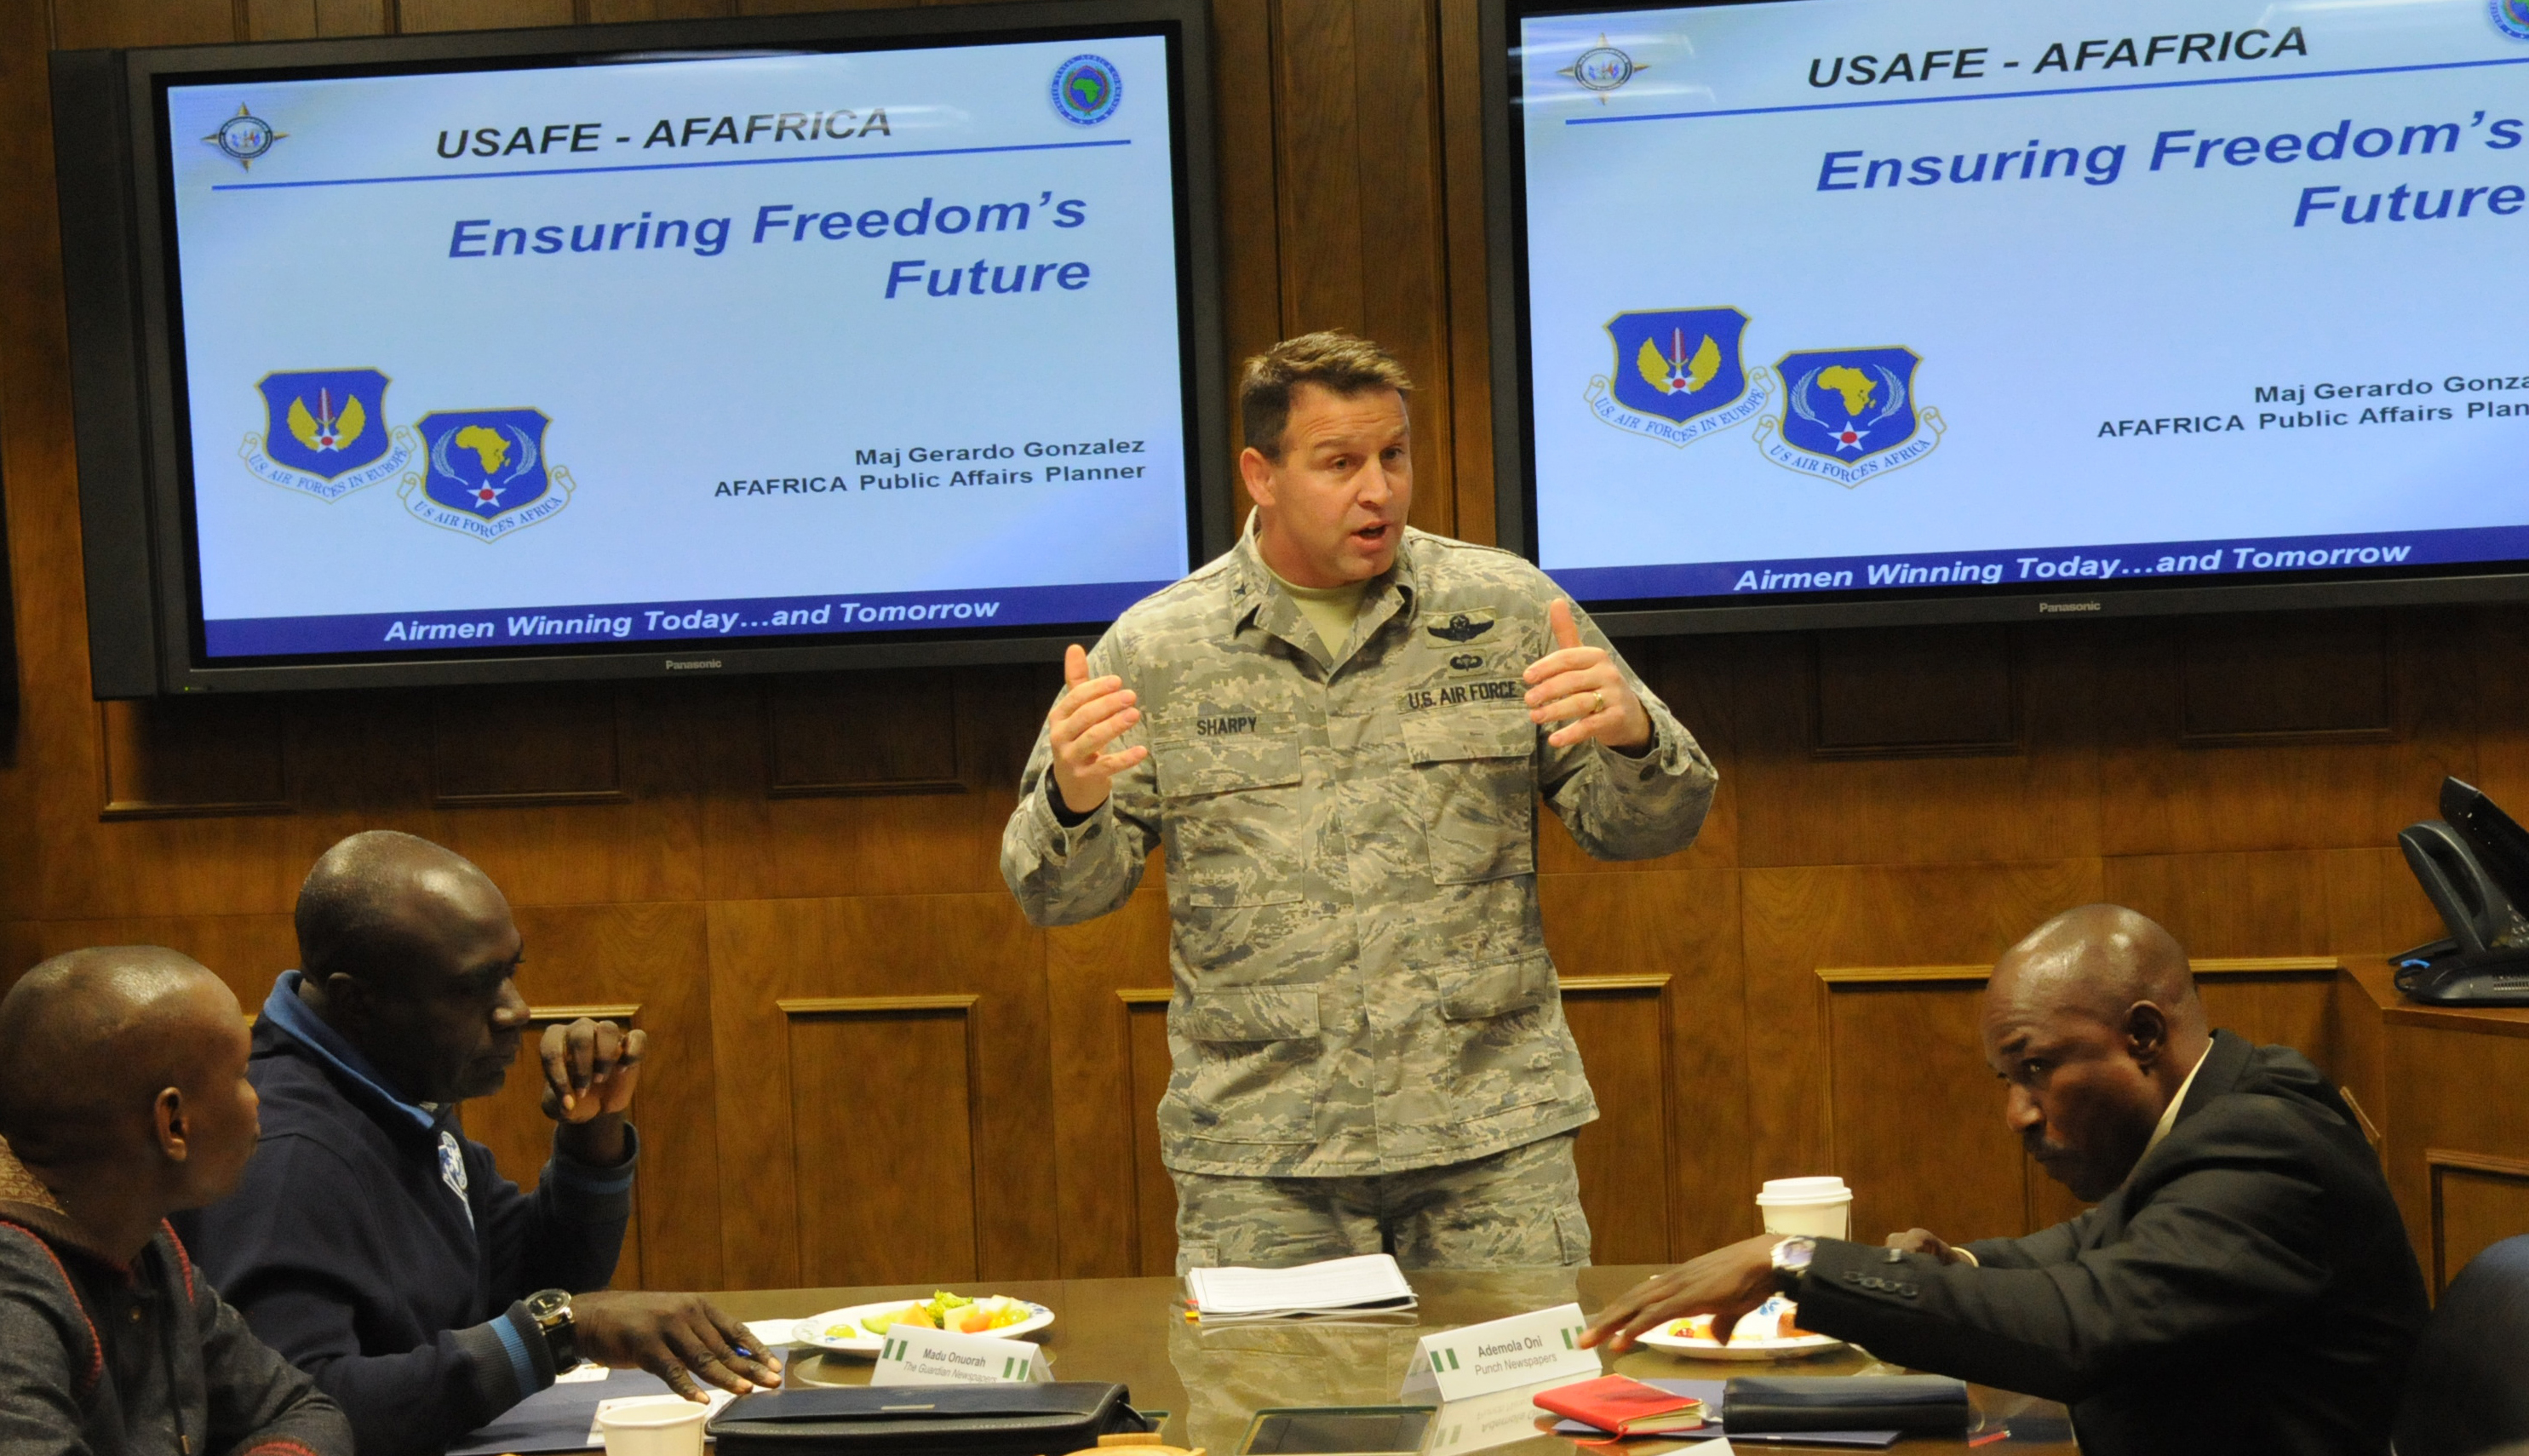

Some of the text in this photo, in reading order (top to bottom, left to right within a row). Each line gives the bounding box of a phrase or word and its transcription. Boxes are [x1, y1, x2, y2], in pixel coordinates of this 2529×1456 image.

[1808, 48, 1988, 89] USAFE
[2033, 26, 2308, 75] AFAFRICA
[437, 123, 602, 159] USAFE
[642, 107, 892, 149] AFAFRICA
[1816, 110, 2525, 192] Ensuring Freedom's
[449, 191, 1087, 257] Ensuring Freedom's
[2293, 183, 2526, 227] Future
[885, 258, 1091, 300] Future
[2254, 384, 2306, 406] Maj
[2314, 378, 2434, 400] Gerardo
[1614, 413, 1640, 429] AIR
[1645, 421, 1698, 443] FORCES
[1701, 418, 1718, 433] IN
[1718, 388, 1766, 424] EUROPE
[2097, 414, 2245, 439] AFAFRICA
[2258, 409, 2348, 430] Public
[2358, 403, 2453, 425] Affairs
[267, 470, 294, 485] AIR
[296, 476, 346, 498] FORCES
[348, 475, 364, 488] IN
[364, 446, 409, 480] EUROPE
[856, 438, 1145, 469] Maj Gerardo Gonzalez
[1792, 455, 1819, 471] AIR
[1821, 461, 1878, 483] FORCES
[1884, 439, 1931, 467] AFRICA
[714, 462, 1146, 498] AFAFRICA Public Affairs Planner
[434, 513, 460, 527] AIR
[462, 517, 515, 538] FORCES
[519, 496, 563, 525] AFRICA
[1733, 568, 1854, 591] Airmen
[1867, 559, 2004, 584] Winning
[2232, 544, 2412, 570] Tomorrow
[384, 620, 496, 642] Airmen
[508, 612, 633, 638] Winning
[840, 601, 1001, 624] Tomorrow
[2039, 600, 2102, 614] Panasonic
[665, 657, 723, 671] Panasonic
[1408, 680, 1520, 709] U.S. AIR FORCE
[1196, 716, 1258, 736] SHARPY
[922, 1348, 986, 1367] Madu Onuorah
[1475, 1353, 1557, 1376] Punch Newspapers
[1477, 1335, 1543, 1358] Ademola Oni
[903, 1361, 998, 1383] The Guardian Newspapers
